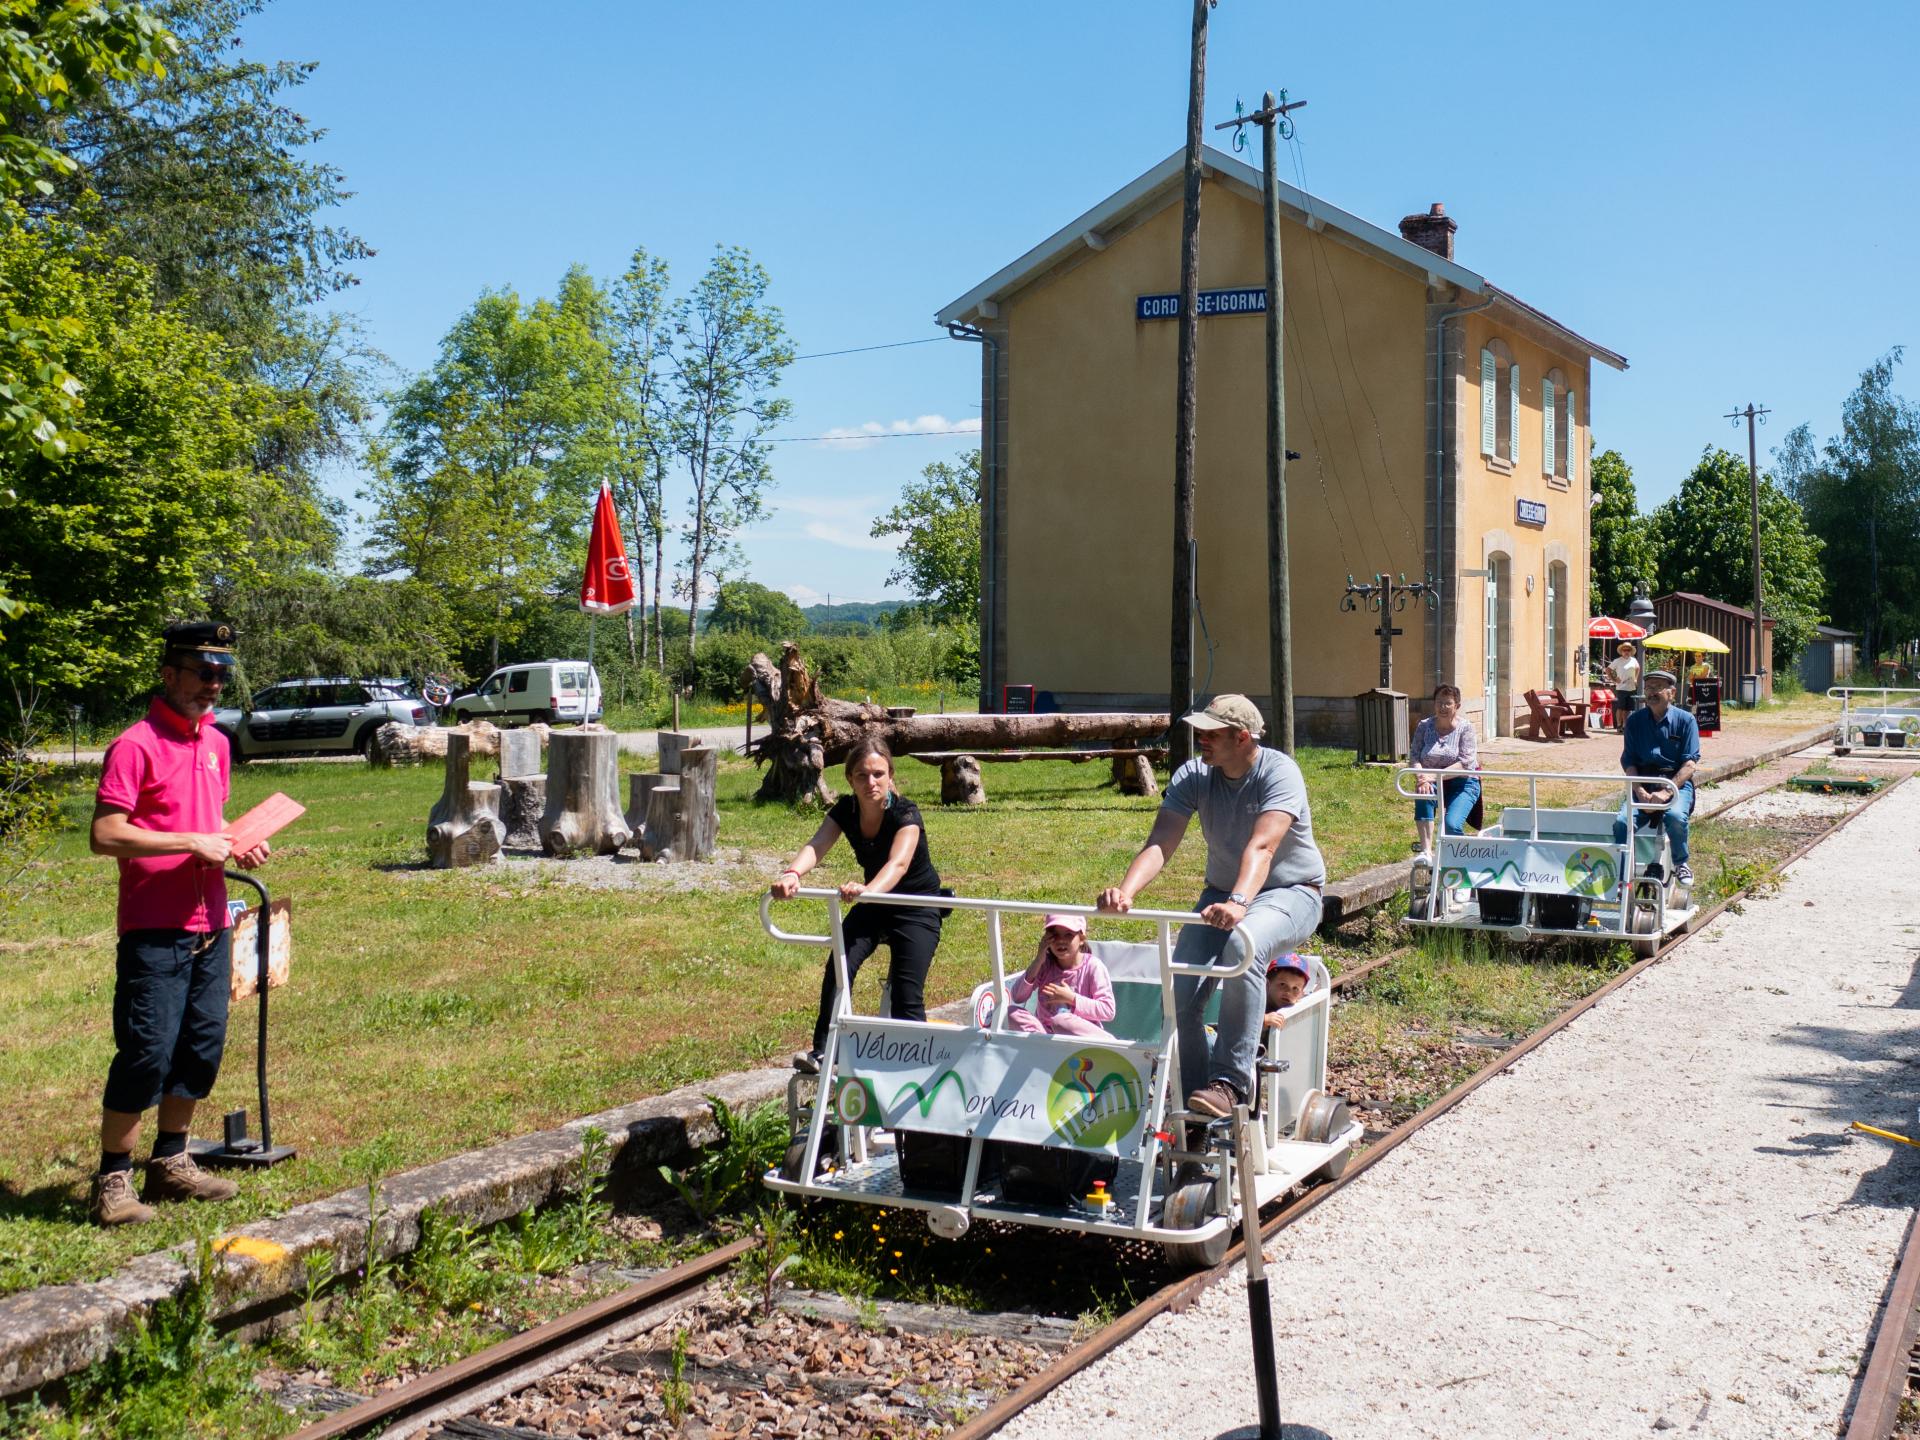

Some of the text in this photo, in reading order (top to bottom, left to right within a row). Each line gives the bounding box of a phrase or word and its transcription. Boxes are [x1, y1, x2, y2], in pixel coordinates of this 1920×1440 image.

[1143, 293, 1267, 316] CORDSE-IGORNA
[1448, 843, 1498, 859] Vélorail
[1447, 873, 1459, 885] 7
[850, 1031, 951, 1065] Vélorail du
[845, 1087, 861, 1117] 6
